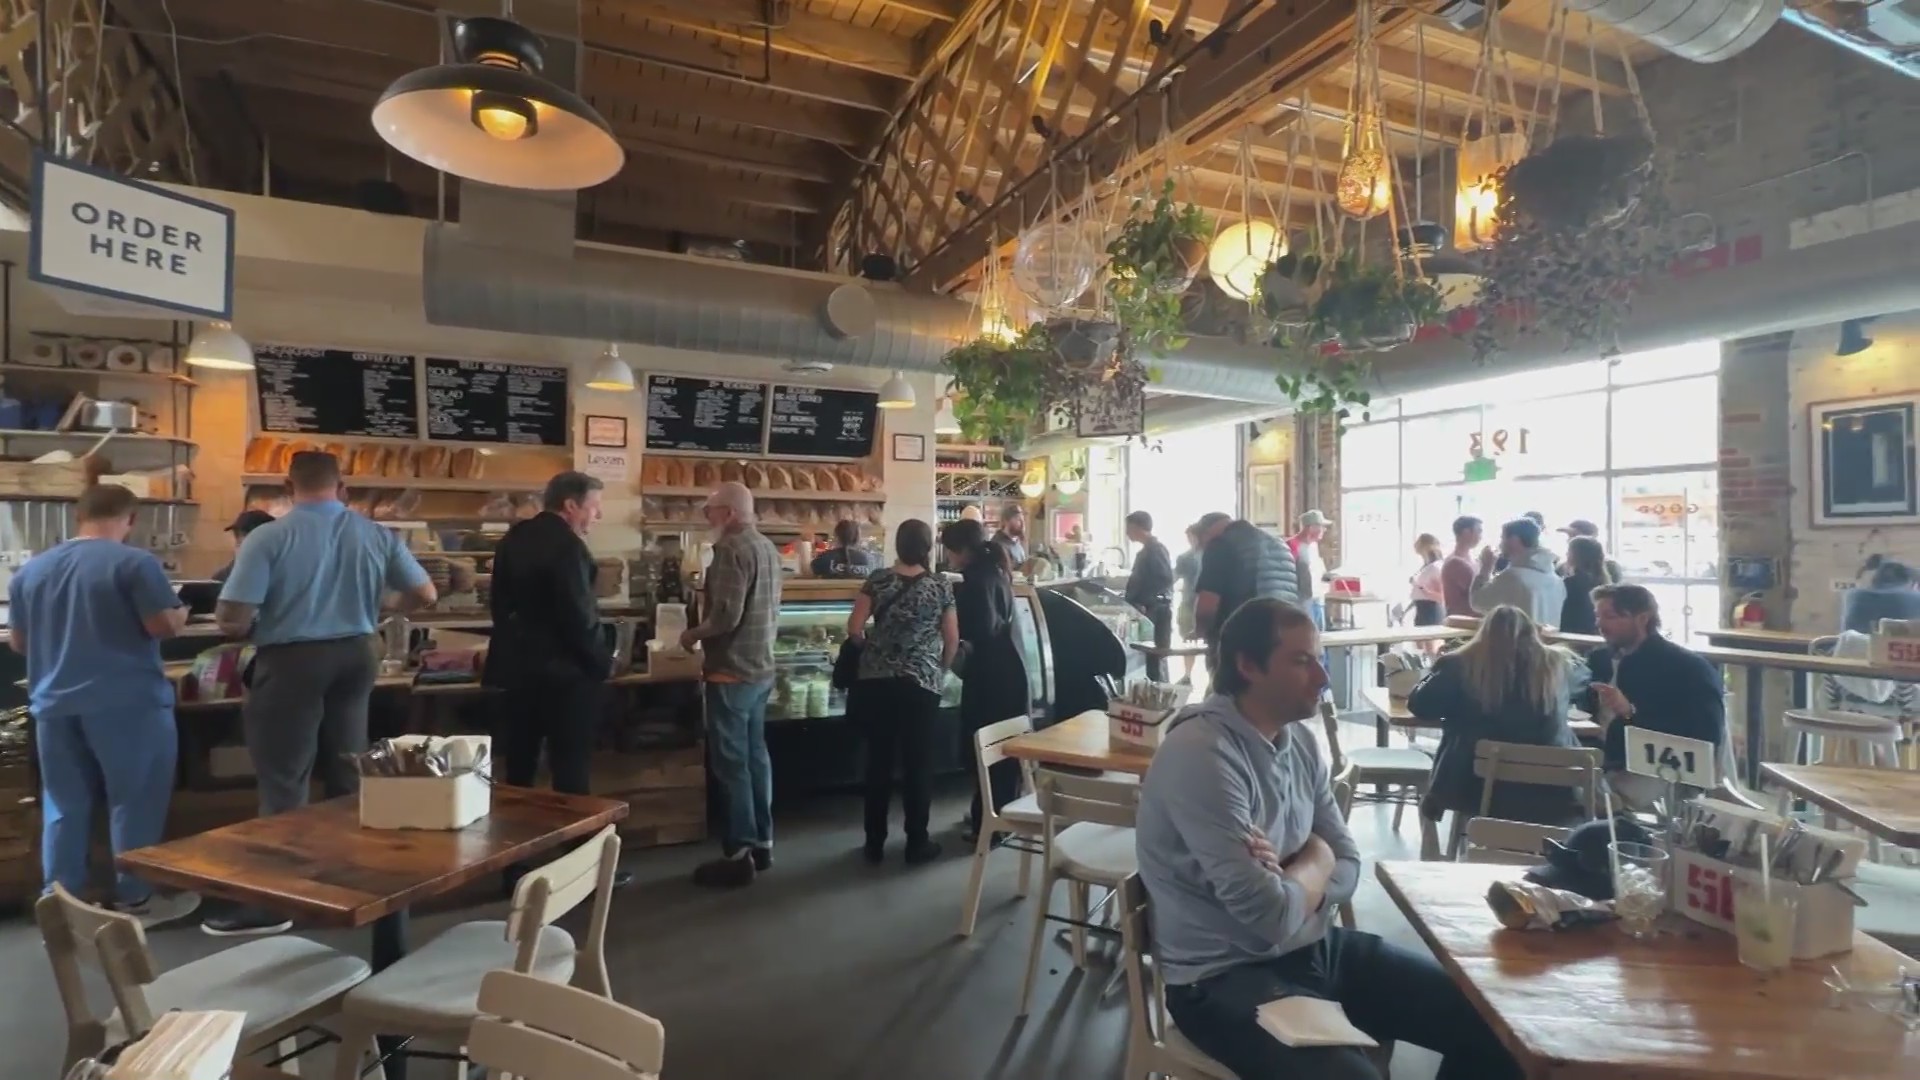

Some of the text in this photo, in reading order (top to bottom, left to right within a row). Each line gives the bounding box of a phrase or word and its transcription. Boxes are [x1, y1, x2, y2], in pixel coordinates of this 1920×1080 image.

[72, 202, 202, 252] ORDER
[91, 234, 187, 275] HERE
[1644, 743, 1695, 773] 141
